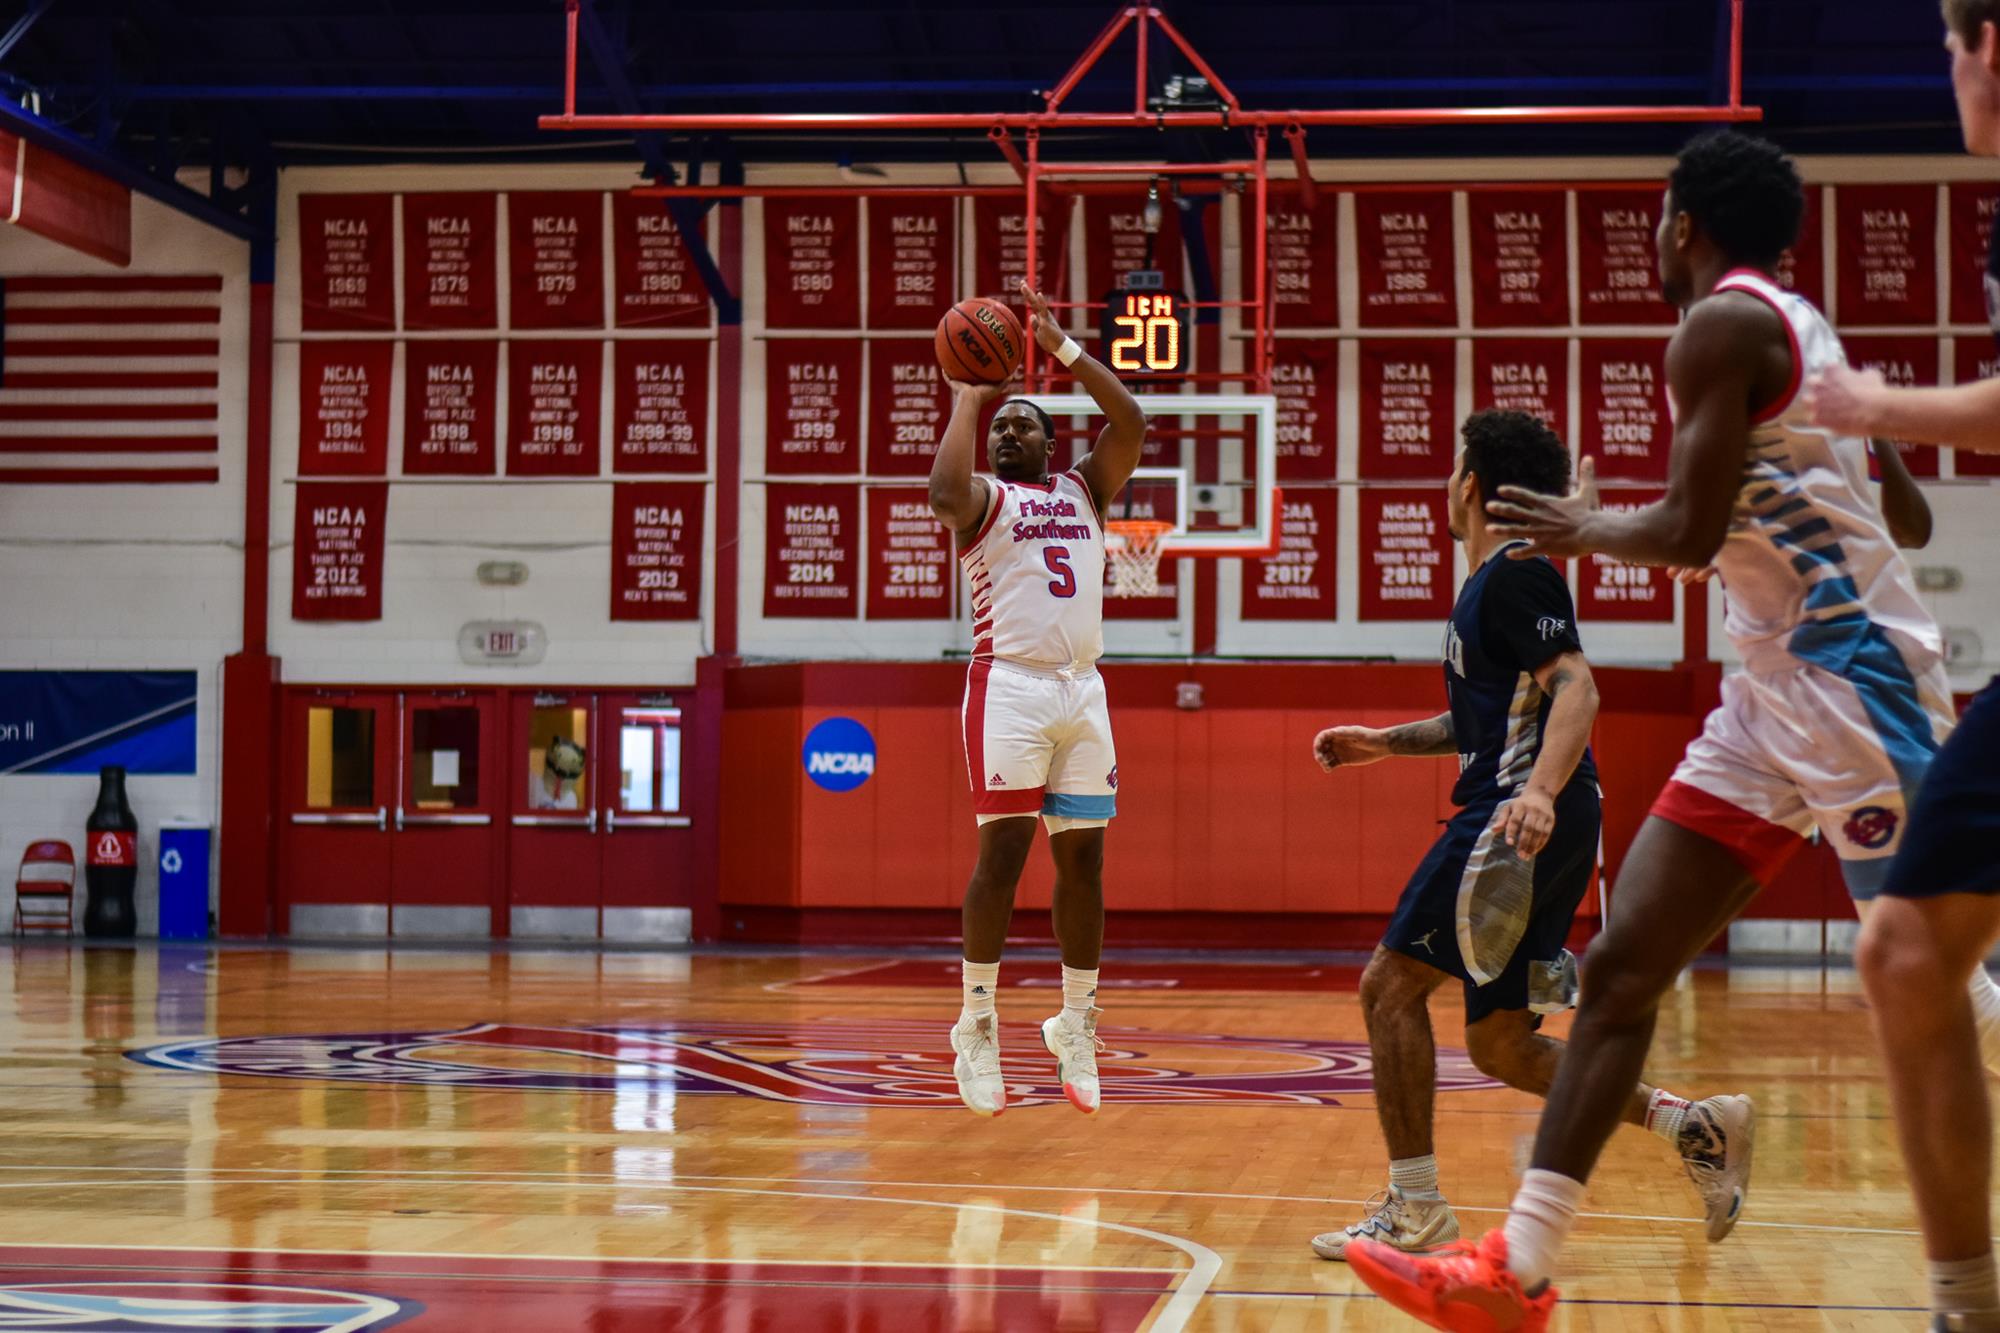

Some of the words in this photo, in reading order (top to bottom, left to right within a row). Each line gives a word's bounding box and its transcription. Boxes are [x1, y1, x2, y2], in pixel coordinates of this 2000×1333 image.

[324, 220, 368, 235] NCAA
[427, 218, 470, 233] NCAA
[532, 218, 578, 233] NCAA
[788, 217, 833, 231] NCAA
[892, 217, 937, 232] NCAA
[1380, 214, 1428, 230] NCAA
[1494, 213, 1541, 229] NCAA
[1603, 211, 1649, 228] NCAA
[1862, 211, 1910, 227] NCAA
[975, 307, 1014, 360] Wilson
[1112, 316, 1178, 370] 20
[323, 366, 366, 381] NCAA
[427, 366, 473, 381] NCAA
[532, 365, 577, 381] NCAA
[635, 365, 684, 381] NCAA
[788, 365, 838, 380] NCAA
[892, 365, 938, 381] NCAA
[1383, 364, 1430, 380] NCAA
[1491, 365, 1548, 382] NCAA
[1601, 363, 1653, 381] NCAA
[313, 508, 366, 525] NCAA
[634, 507, 683, 526] NCAA
[785, 506, 839, 521] NCAA
[1020, 499, 1076, 518] Florida
[1382, 504, 1431, 519] NCAA
[1012, 519, 1091, 542] Southern
[315, 567, 359, 585] 2012
[638, 571, 678, 588] 2013
[788, 563, 834, 582] 2014
[890, 565, 938, 583] 2016
[1043, 546, 1076, 598] 5
[1264, 565, 1313, 583] 2017
[1382, 566, 1431, 584] 2018
[1600, 566, 1650, 585] 2018
[490, 632, 514, 652] EXIT
[809, 751, 875, 775] NCAA
